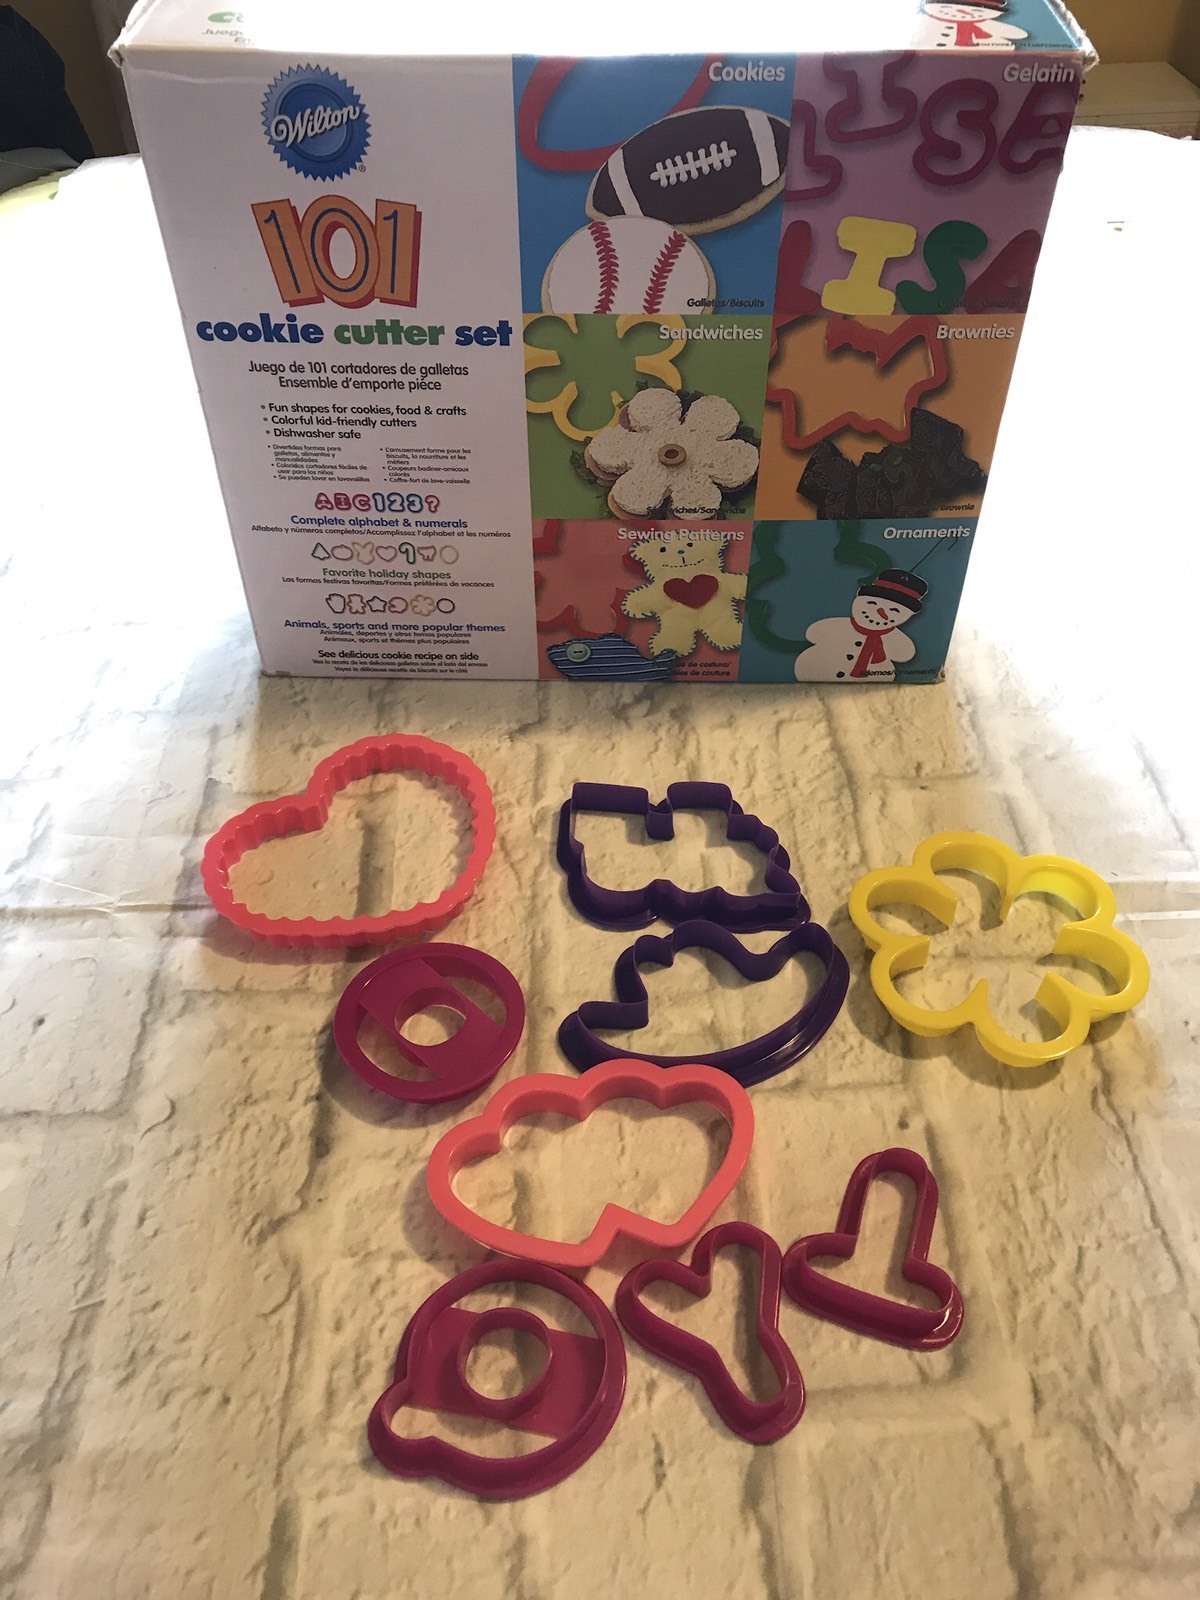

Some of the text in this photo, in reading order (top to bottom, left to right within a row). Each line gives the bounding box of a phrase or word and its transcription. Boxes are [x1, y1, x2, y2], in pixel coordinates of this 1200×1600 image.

[708, 60, 786, 82] Cookies
[1003, 62, 1075, 82] Gelatin
[270, 103, 360, 148] Wilton
[251, 194, 422, 309] 101
[687, 298, 765, 308] Galletas/Biscuits
[196, 312, 513, 347] cookie cutter set
[659, 324, 763, 341] Sandwiches
[936, 323, 1016, 340] Brownies
[248, 360, 469, 378] Juego de 101 cortadores de galletas
[279, 376, 338, 389] Ensemble
[341, 377, 405, 392] d'emporte
[269, 403, 467, 416] Fun shapes for cookies, food & crafts
[271, 415, 417, 429] Colorful kid-friendly cutters
[274, 428, 361, 439] Dishwasher safe
[291, 515, 468, 528] Complete alphabet & numerals
[617, 528, 745, 543] Sewing Patterns
[883, 525, 971, 539] Ornaments
[322, 568, 451, 580] Favorite holiday shapes
[284, 619, 505, 632] Animals, sports and more popular themes
[318, 649, 336, 658] See
[338, 650, 379, 659] delicious
[381, 651, 412, 660] cookie
[414, 652, 443, 661] recipe
[460, 652, 479, 660] side
